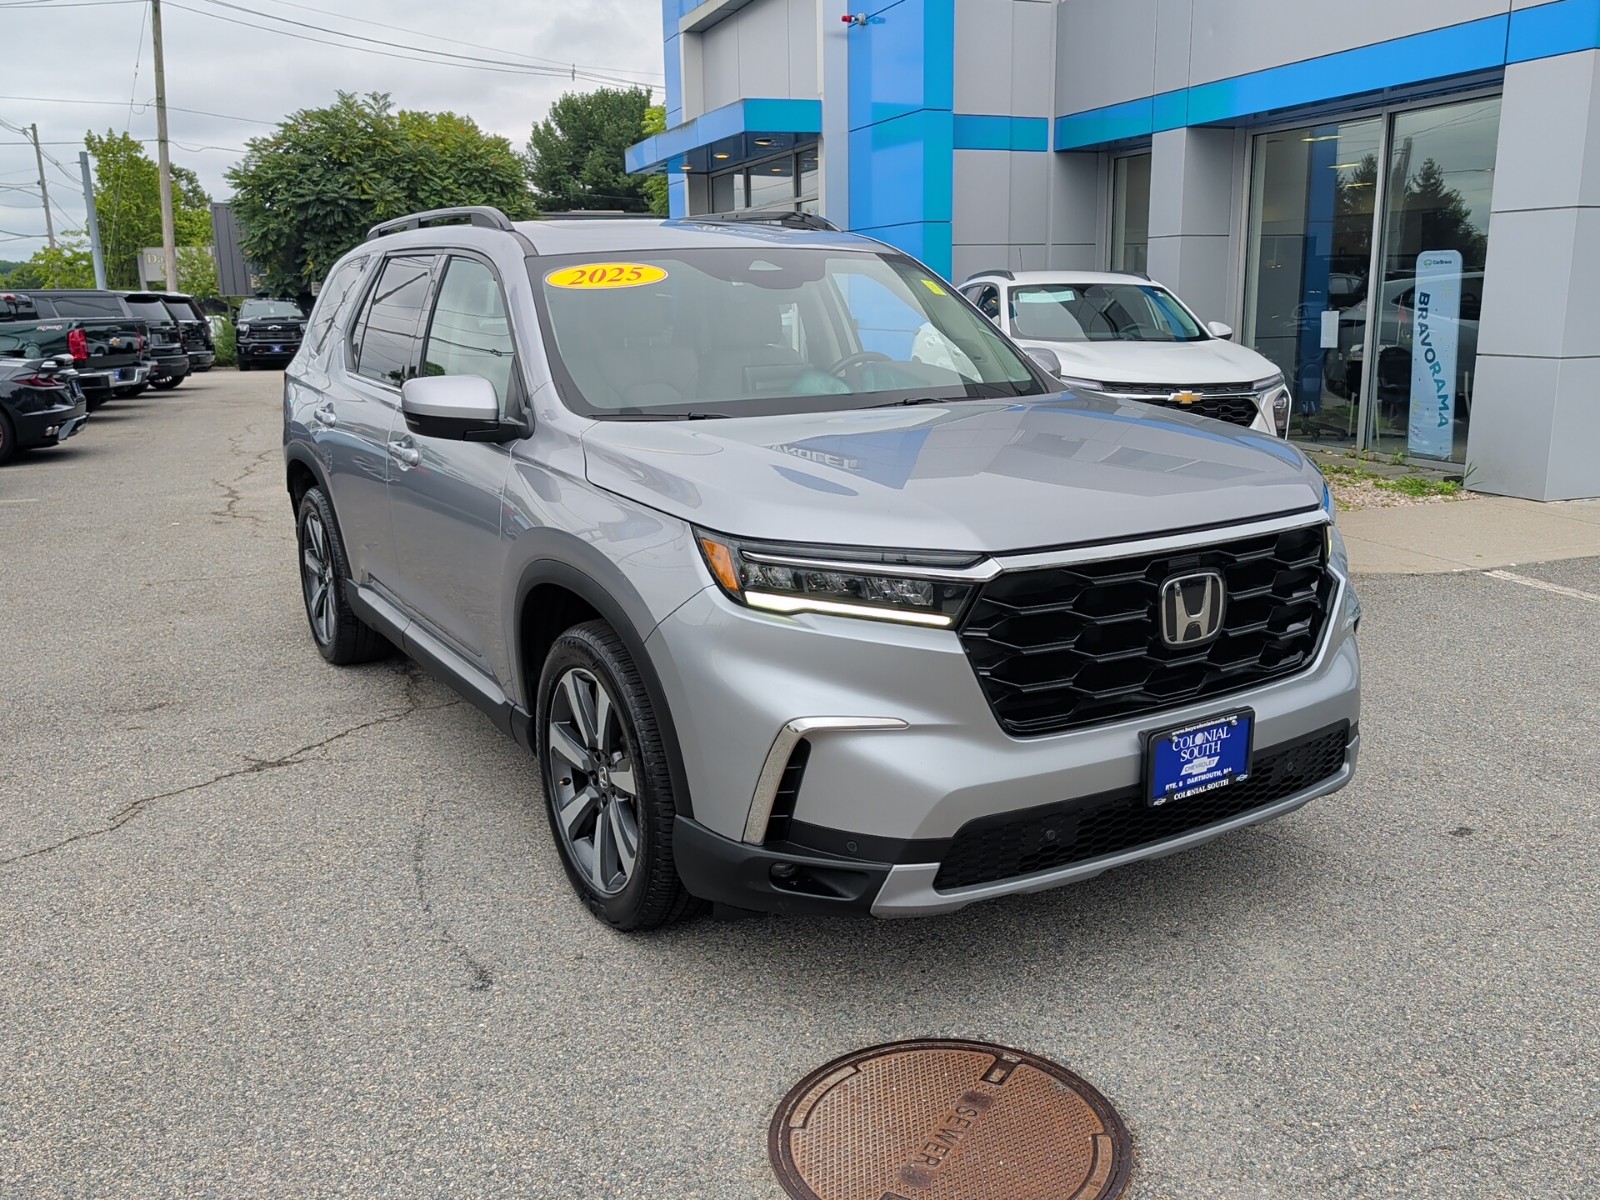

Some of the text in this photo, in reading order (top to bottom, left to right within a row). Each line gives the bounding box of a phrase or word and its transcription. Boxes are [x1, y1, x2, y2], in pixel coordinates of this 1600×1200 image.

[567, 267, 644, 286] 2025
[1417, 291, 1450, 428] BRAVORAMA
[1172, 726, 1231, 751] COLONIAL
[1180, 740, 1221, 762] SOUTH
[1184, 759, 1216, 773] CHEVROLET
[1173, 778, 1229, 800] COLONIAL SOUTH
[913, 1105, 978, 1166] SEWER
